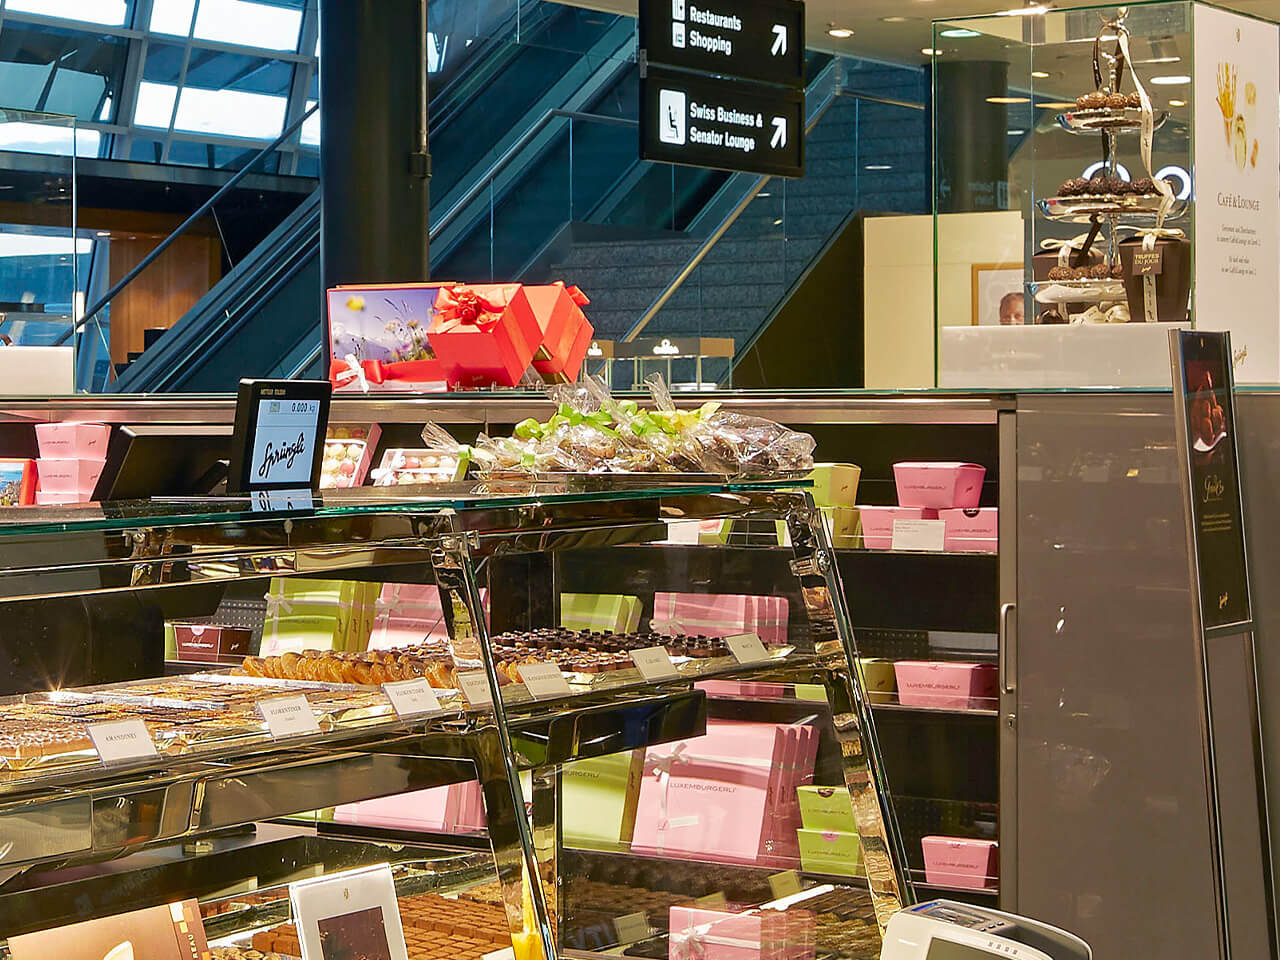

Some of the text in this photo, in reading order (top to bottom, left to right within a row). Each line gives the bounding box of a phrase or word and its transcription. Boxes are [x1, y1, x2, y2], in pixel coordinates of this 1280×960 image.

[690, 6, 741, 31] Restaurants
[690, 30, 732, 56] Shopping
[690, 102, 763, 128] Swiss Business &
[690, 126, 755, 152] Senator Lounge
[292, 402, 308, 412] 0.000
